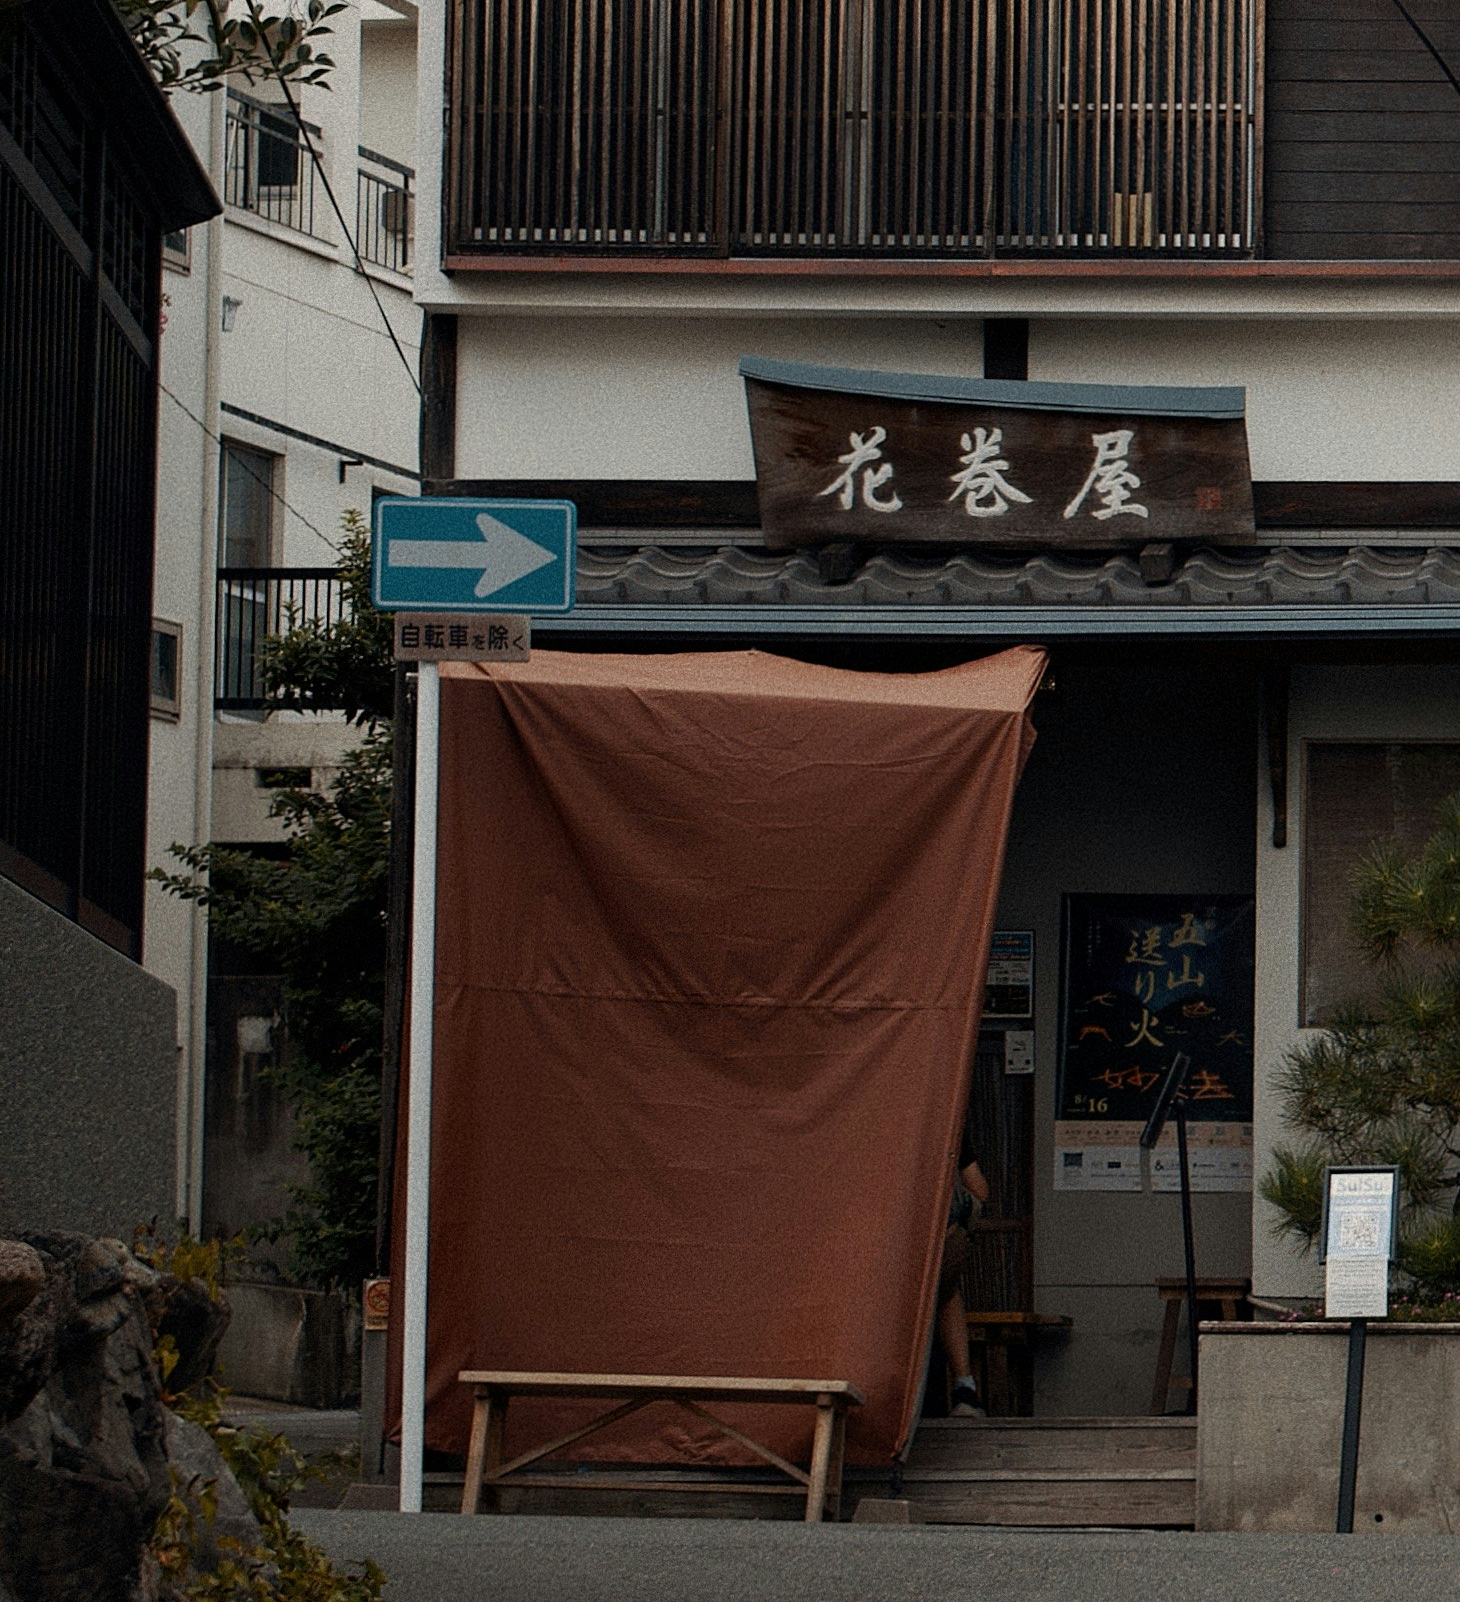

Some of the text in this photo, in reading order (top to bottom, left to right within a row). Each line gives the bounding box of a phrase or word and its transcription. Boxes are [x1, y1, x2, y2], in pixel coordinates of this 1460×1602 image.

[817, 425, 1151, 522] 花巻屋
[401, 623, 524, 650] 自転車を除く
